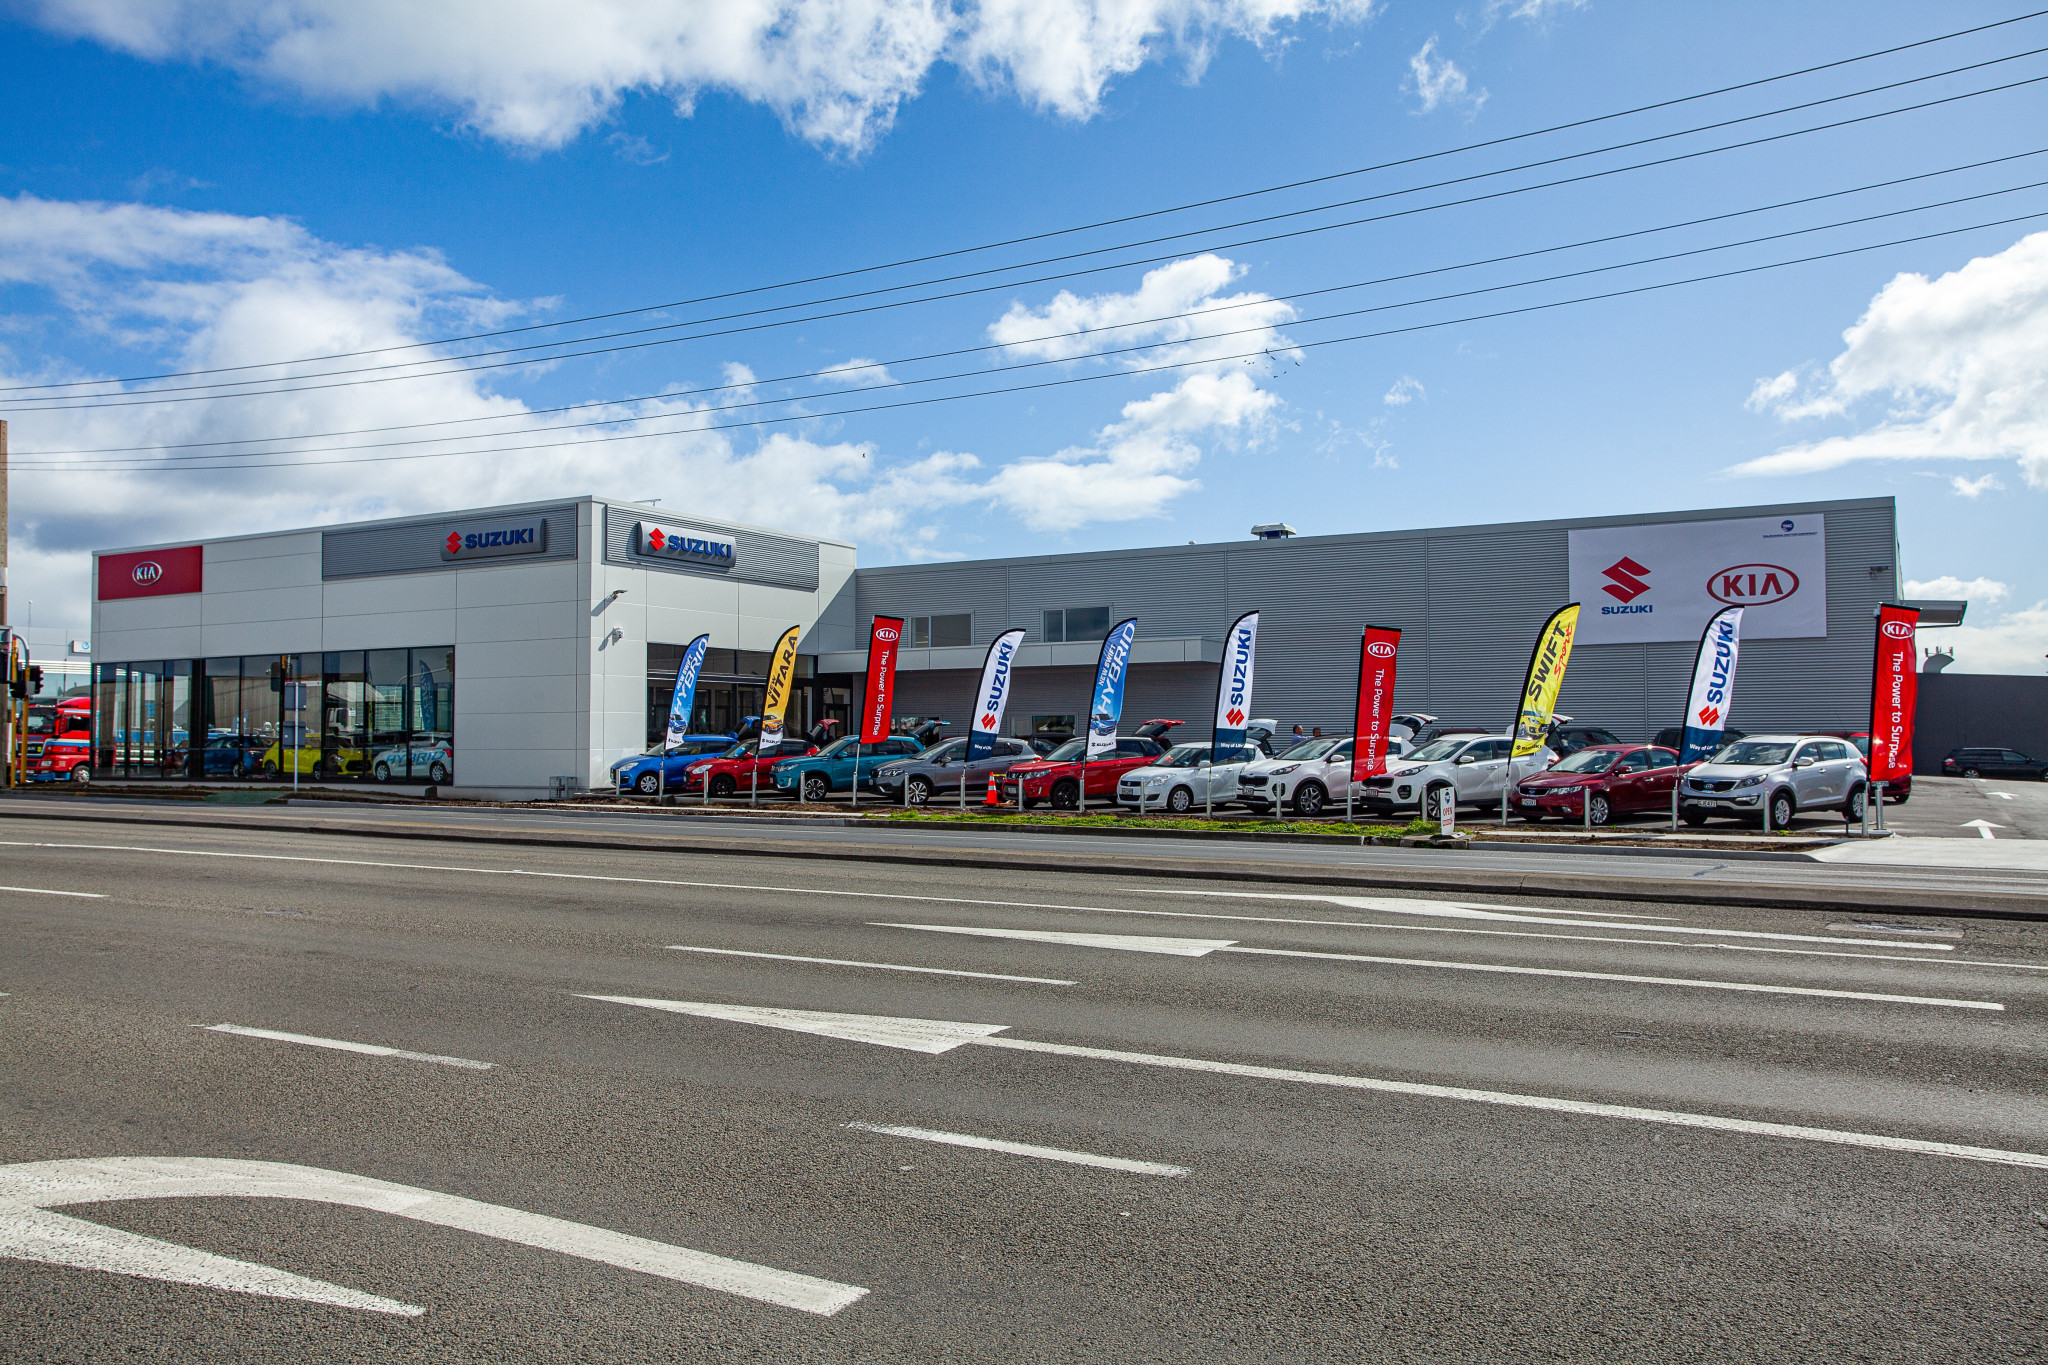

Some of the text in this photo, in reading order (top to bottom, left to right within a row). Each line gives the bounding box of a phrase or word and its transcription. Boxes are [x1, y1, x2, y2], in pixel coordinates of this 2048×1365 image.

[465, 528, 534, 549] SUZUKI
[668, 534, 732, 559] SUZUKI
[136, 566, 157, 580] KIA
[1722, 573, 1784, 597] KIA
[1601, 604, 1653, 615] SUZUKI
[880, 630, 895, 639] KIA
[1886, 625, 1910, 636] KIA
[1098, 644, 1116, 686] NEW SWIFT
[1372, 645, 1392, 655] KIA
[1528, 620, 1565, 702] SWIFT
[1553, 622, 1572, 682] Sport
[1707, 620, 1733, 704] SUZUKI
[674, 637, 708, 714] HYBRID
[768, 636, 798, 709] VITARA
[987, 642, 1013, 712] SUZUKI
[1097, 622, 1135, 714] HYBRID
[1230, 629, 1251, 706] SUZUKI
[768, 675, 776, 696] NEW
[872, 650, 889, 736] The Power to Surprise
[1367, 668, 1384, 771] The Power to Surprise
[1888, 651, 1903, 769] The Power to Surprise
[974, 743, 983, 751] Way
[1689, 743, 1701, 751] Way
[1443, 807, 1453, 816] OPEN
